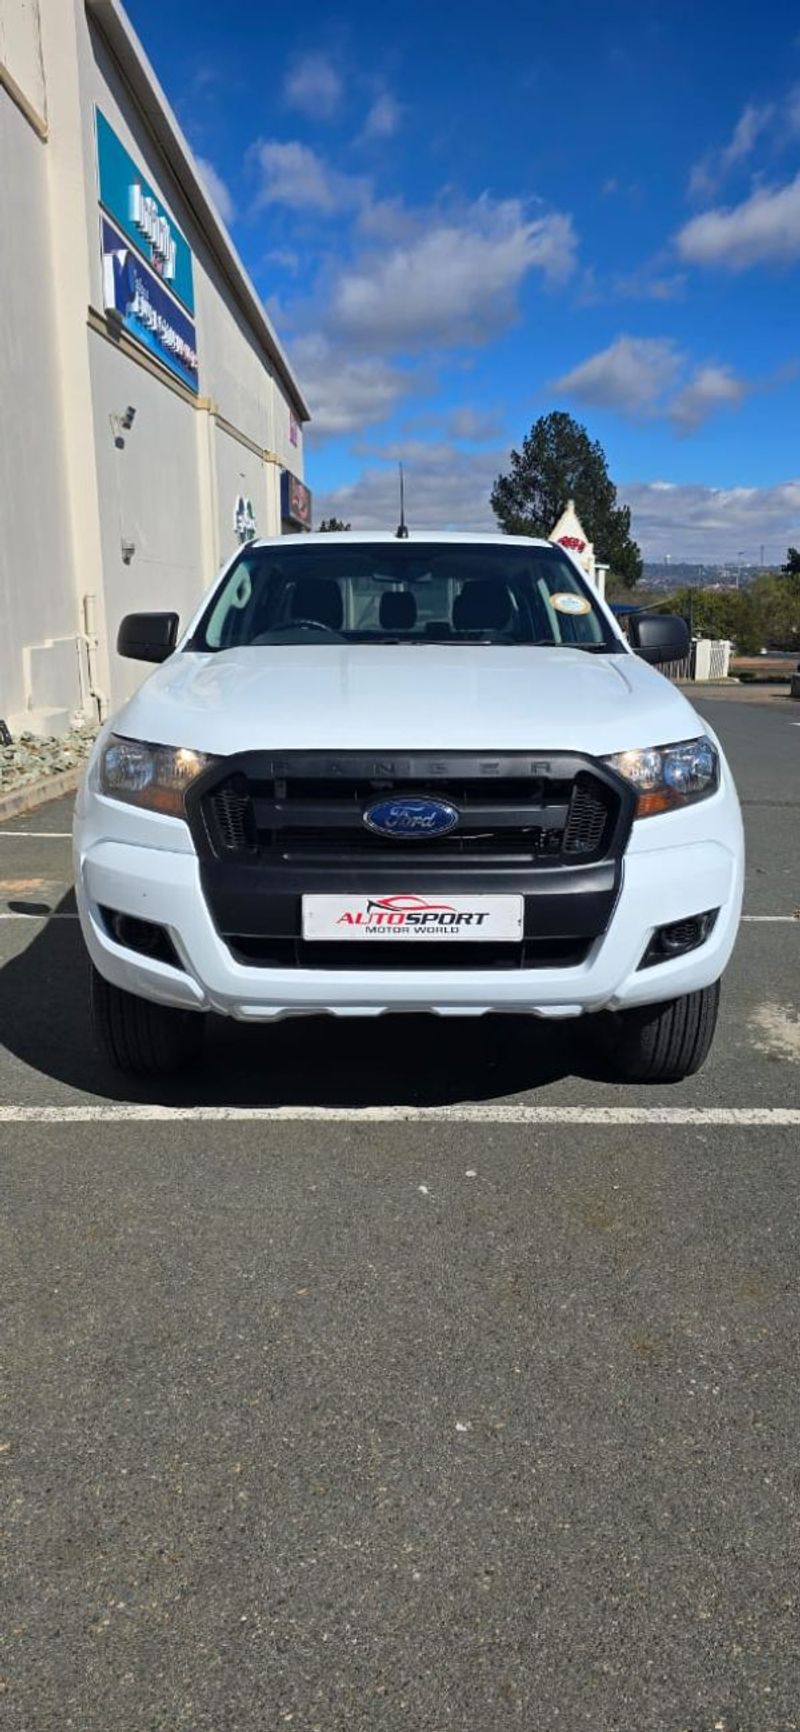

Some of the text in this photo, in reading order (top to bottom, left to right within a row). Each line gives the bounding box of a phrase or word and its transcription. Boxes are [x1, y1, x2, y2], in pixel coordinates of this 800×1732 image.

[269, 760, 553, 775] RANGER
[385, 806, 437, 828] Ford
[335, 912, 491, 926] AUTOSPORT
[365, 926, 460, 934] MOTOR WORLD
